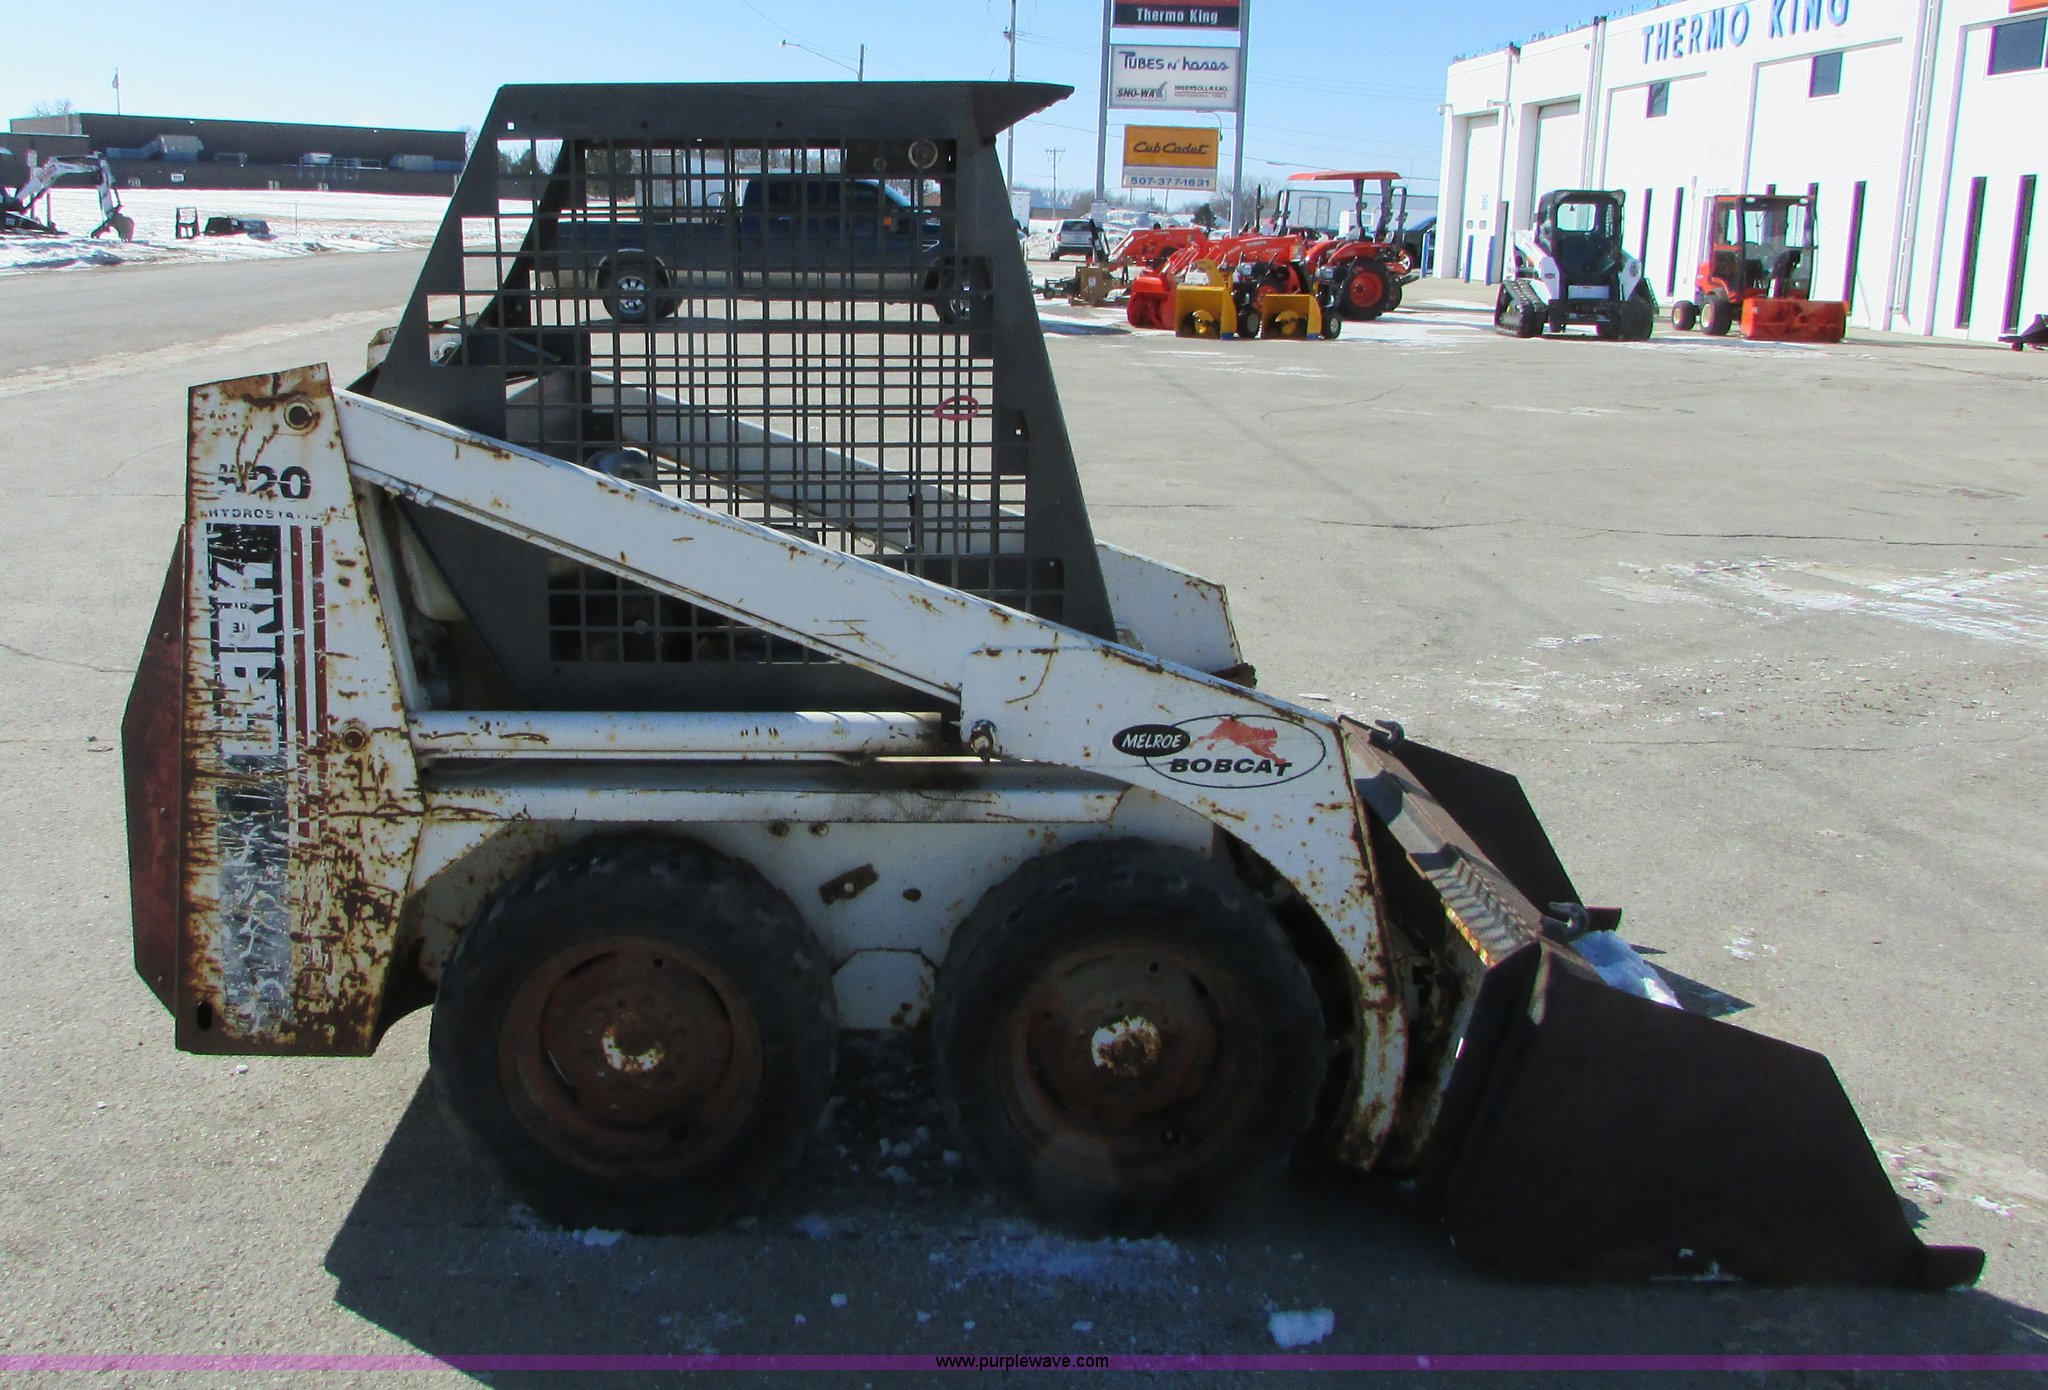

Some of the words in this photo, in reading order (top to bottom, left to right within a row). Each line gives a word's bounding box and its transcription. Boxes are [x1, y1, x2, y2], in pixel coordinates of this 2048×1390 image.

[1137, 8, 1184, 22] Thermo
[1190, 9, 1218, 24] King
[1642, 4, 1749, 64] THERMO
[1768, 0, 1849, 38] KING
[1119, 51, 1164, 70] TUBES
[1183, 57, 1229, 71] hoses
[1133, 142, 1161, 153] Cub
[1162, 143, 1209, 154] Cadet
[1121, 733, 1182, 749] MELROE
[1170, 758, 1292, 776] BOBCAT
